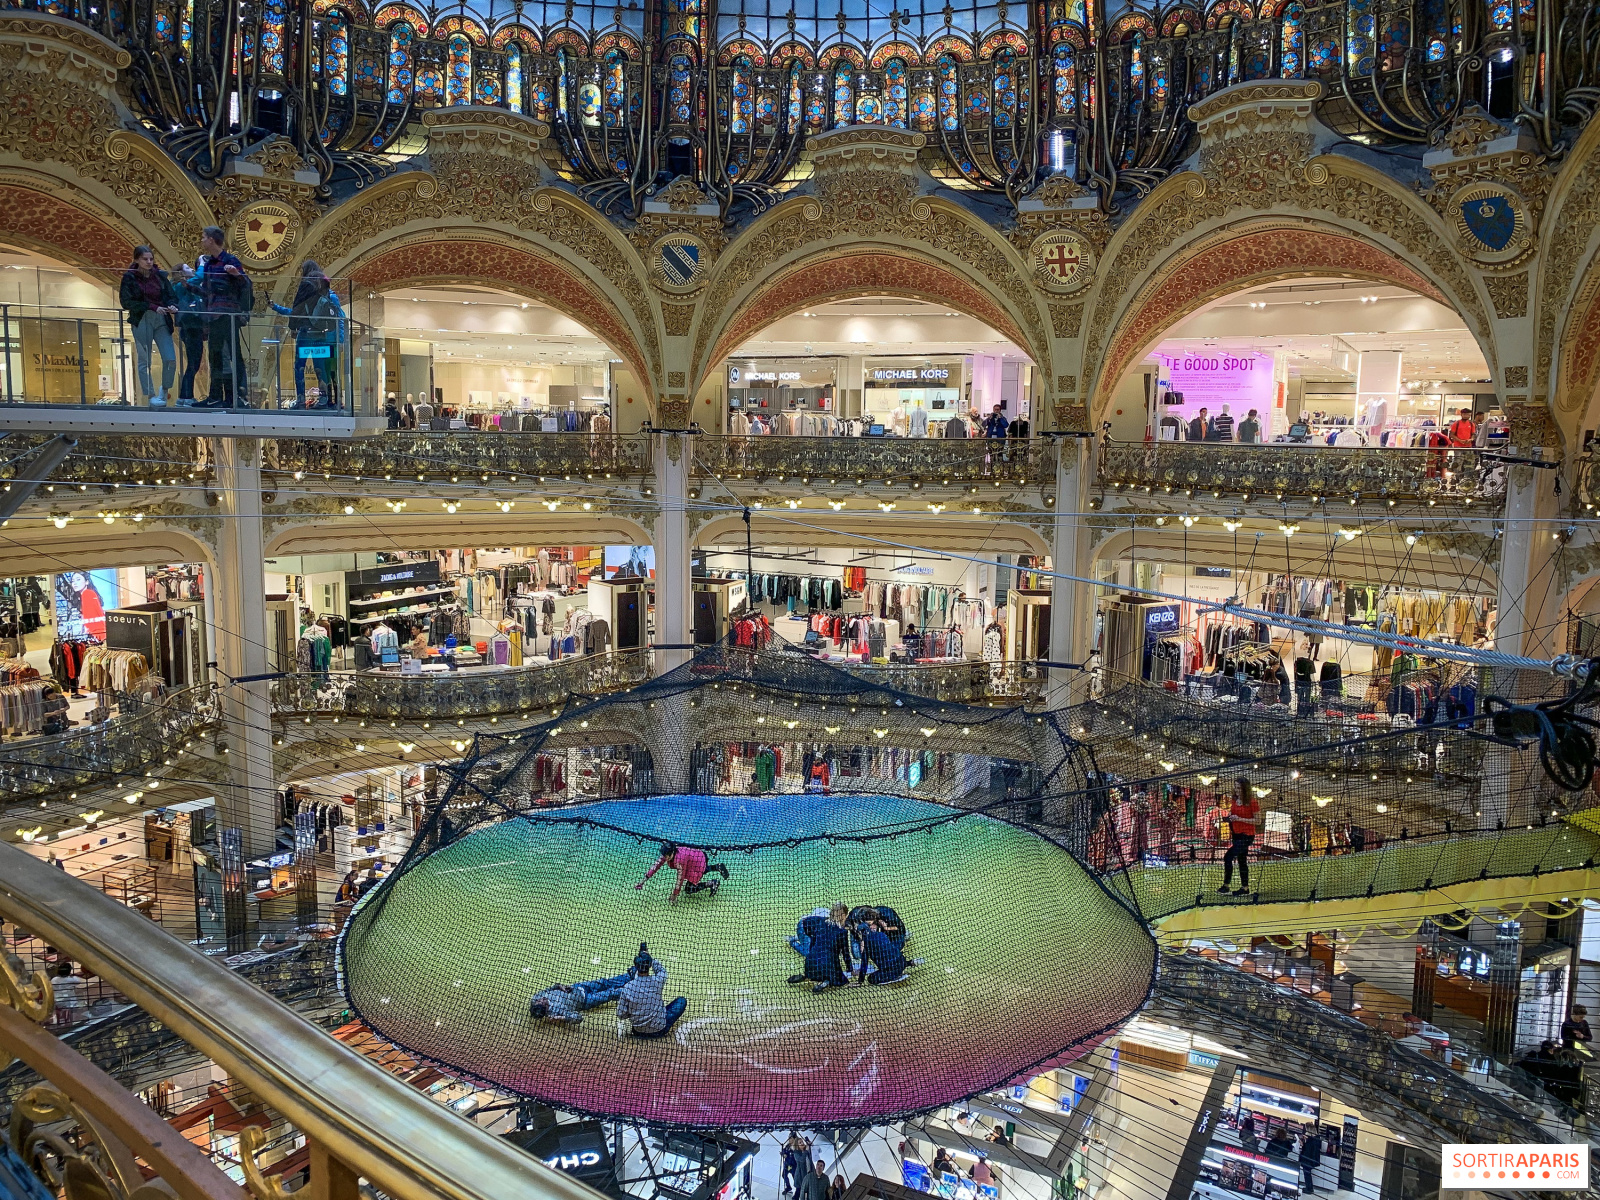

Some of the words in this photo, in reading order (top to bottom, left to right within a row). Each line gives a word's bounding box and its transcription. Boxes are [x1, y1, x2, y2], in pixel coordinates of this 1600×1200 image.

[44, 354, 89, 367] MaxMaa
[1184, 358, 1219, 371] GOOD
[1222, 358, 1256, 371] SPOT
[744, 372, 777, 381] MICHAEL
[779, 372, 801, 381] KORS
[874, 369, 918, 380] MICHAEL
[920, 369, 949, 379] KORS
[108, 614, 136, 624] soeur
[1148, 611, 1175, 624] KENZO
[1002, 1104, 1023, 1114] MER
[1224, 1145, 1254, 1159] TRENDING
[1254, 1153, 1270, 1163] NOW
